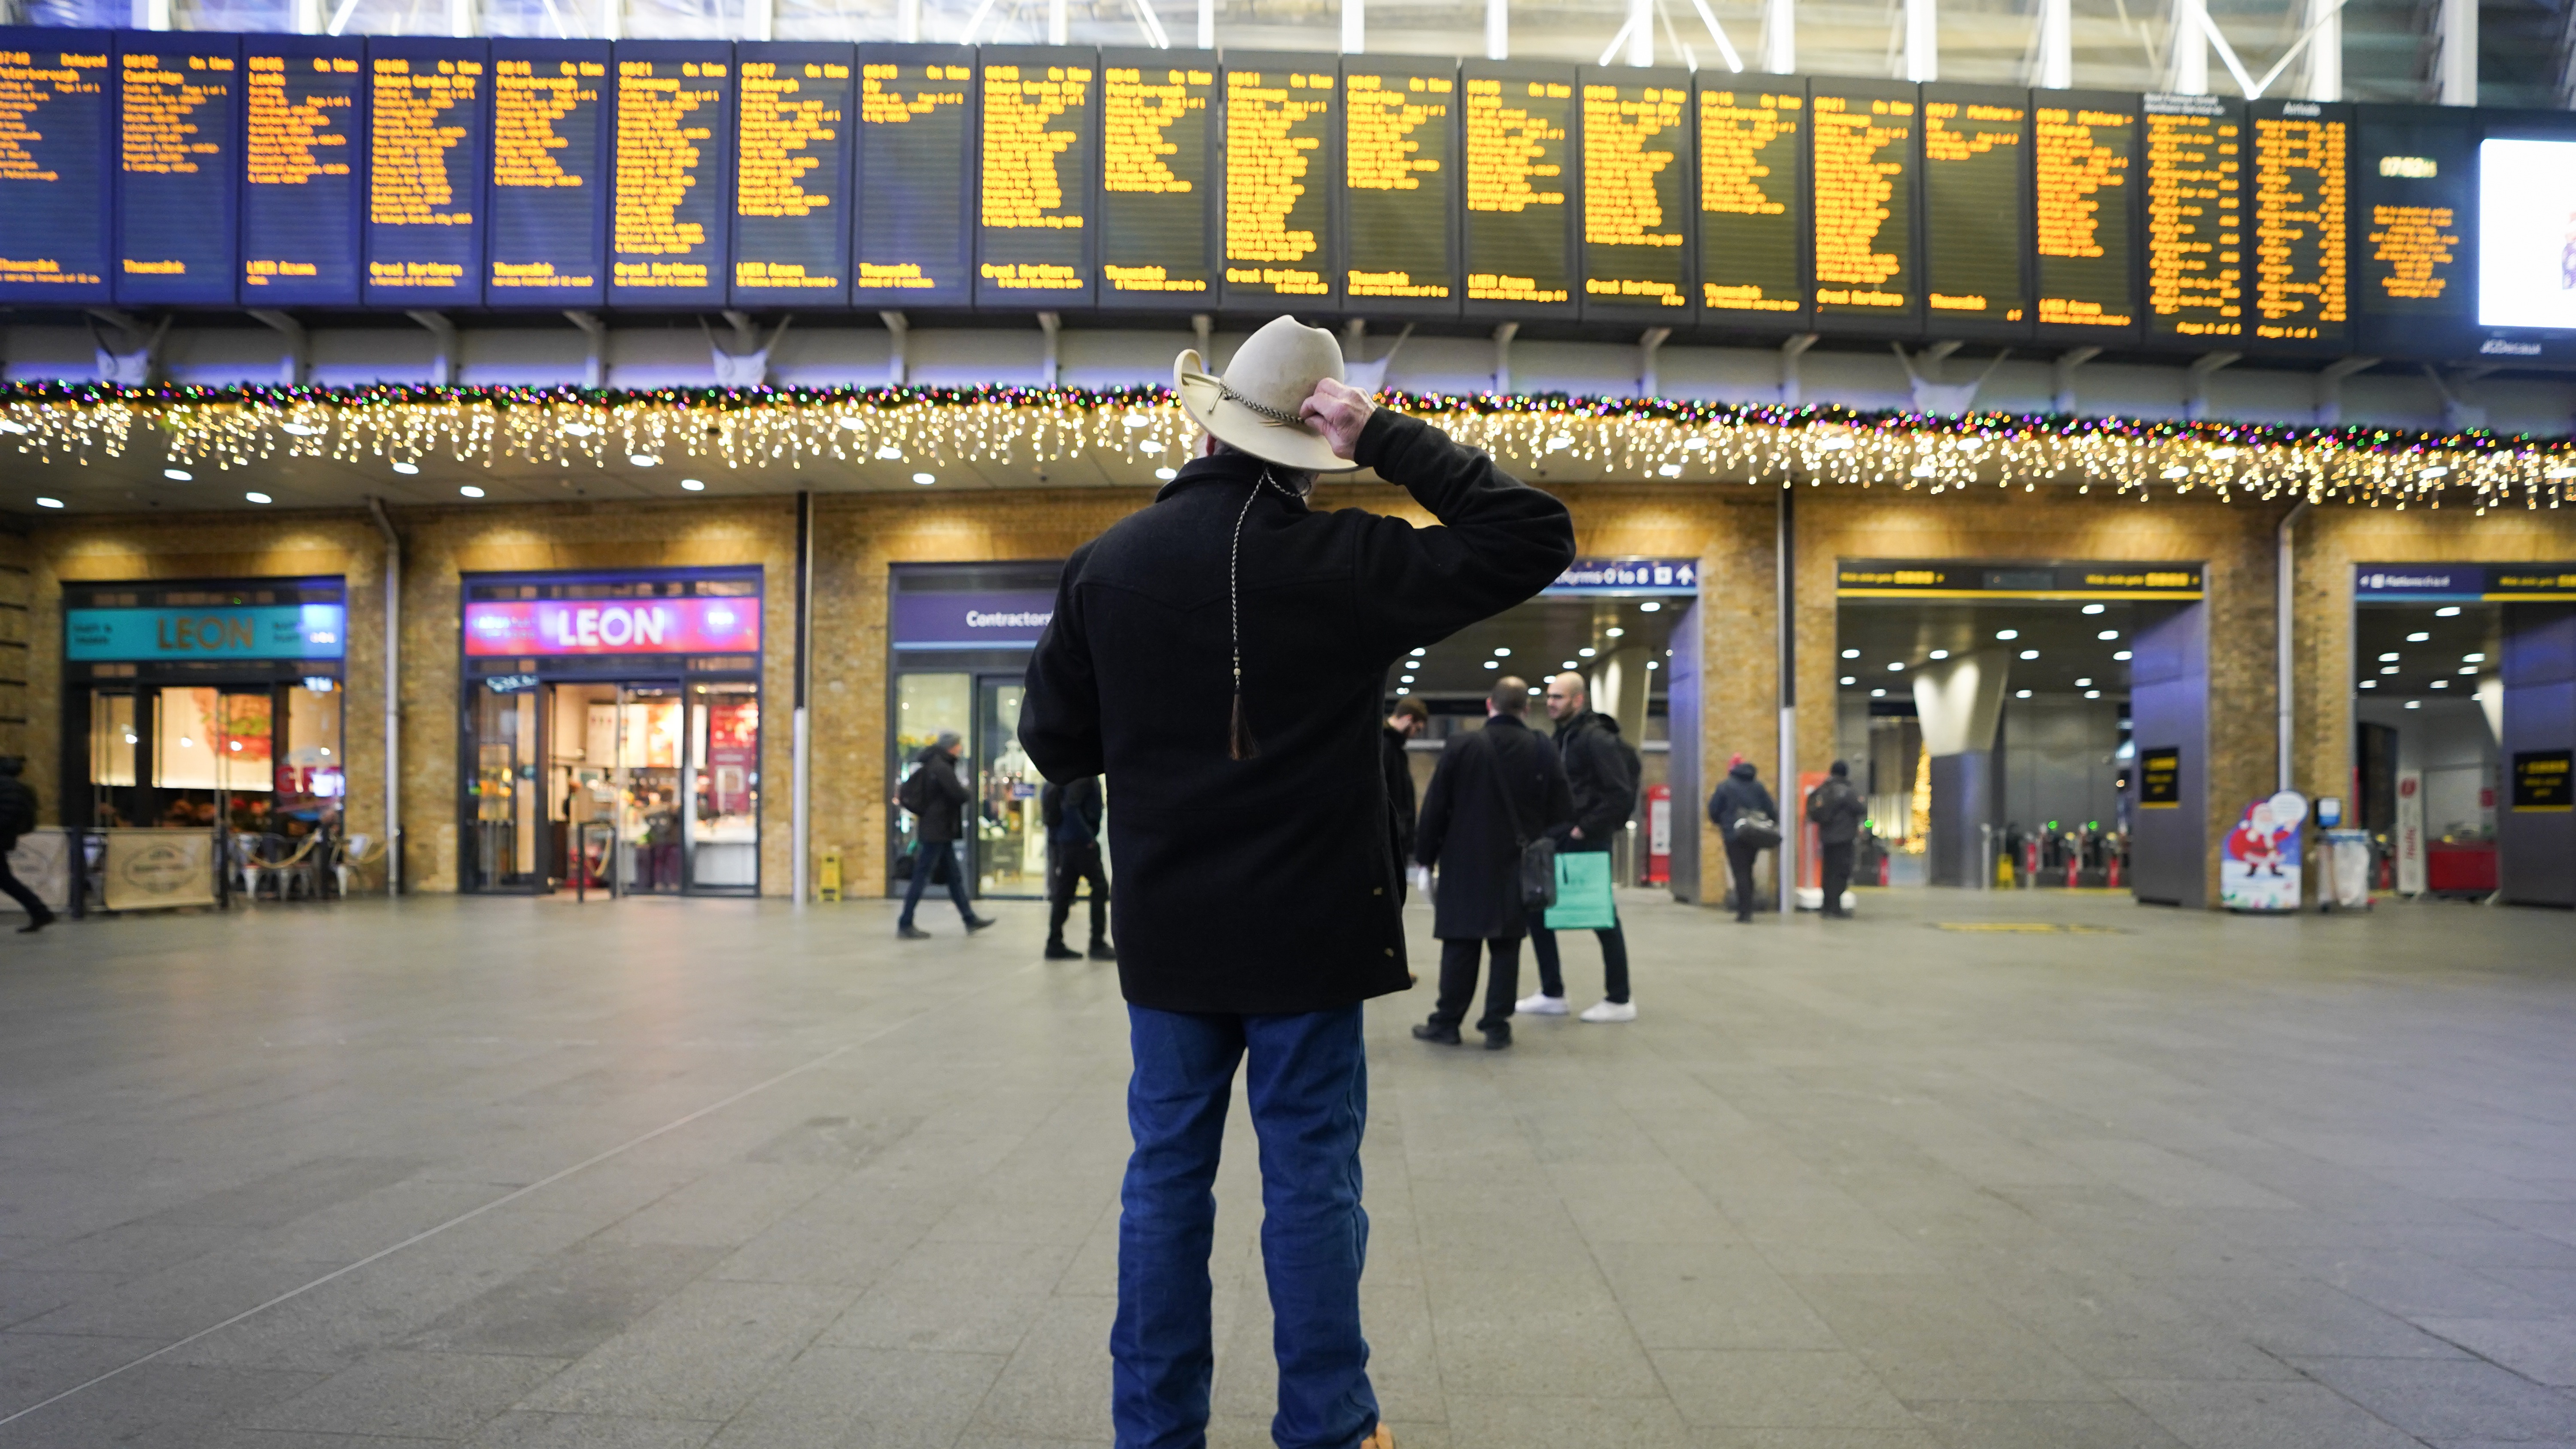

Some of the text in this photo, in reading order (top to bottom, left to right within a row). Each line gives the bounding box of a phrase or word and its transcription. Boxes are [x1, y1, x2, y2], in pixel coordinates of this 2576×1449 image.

[1617, 569, 1636, 585] to
[157, 615, 254, 650] LEON
[557, 606, 665, 647] LEON
